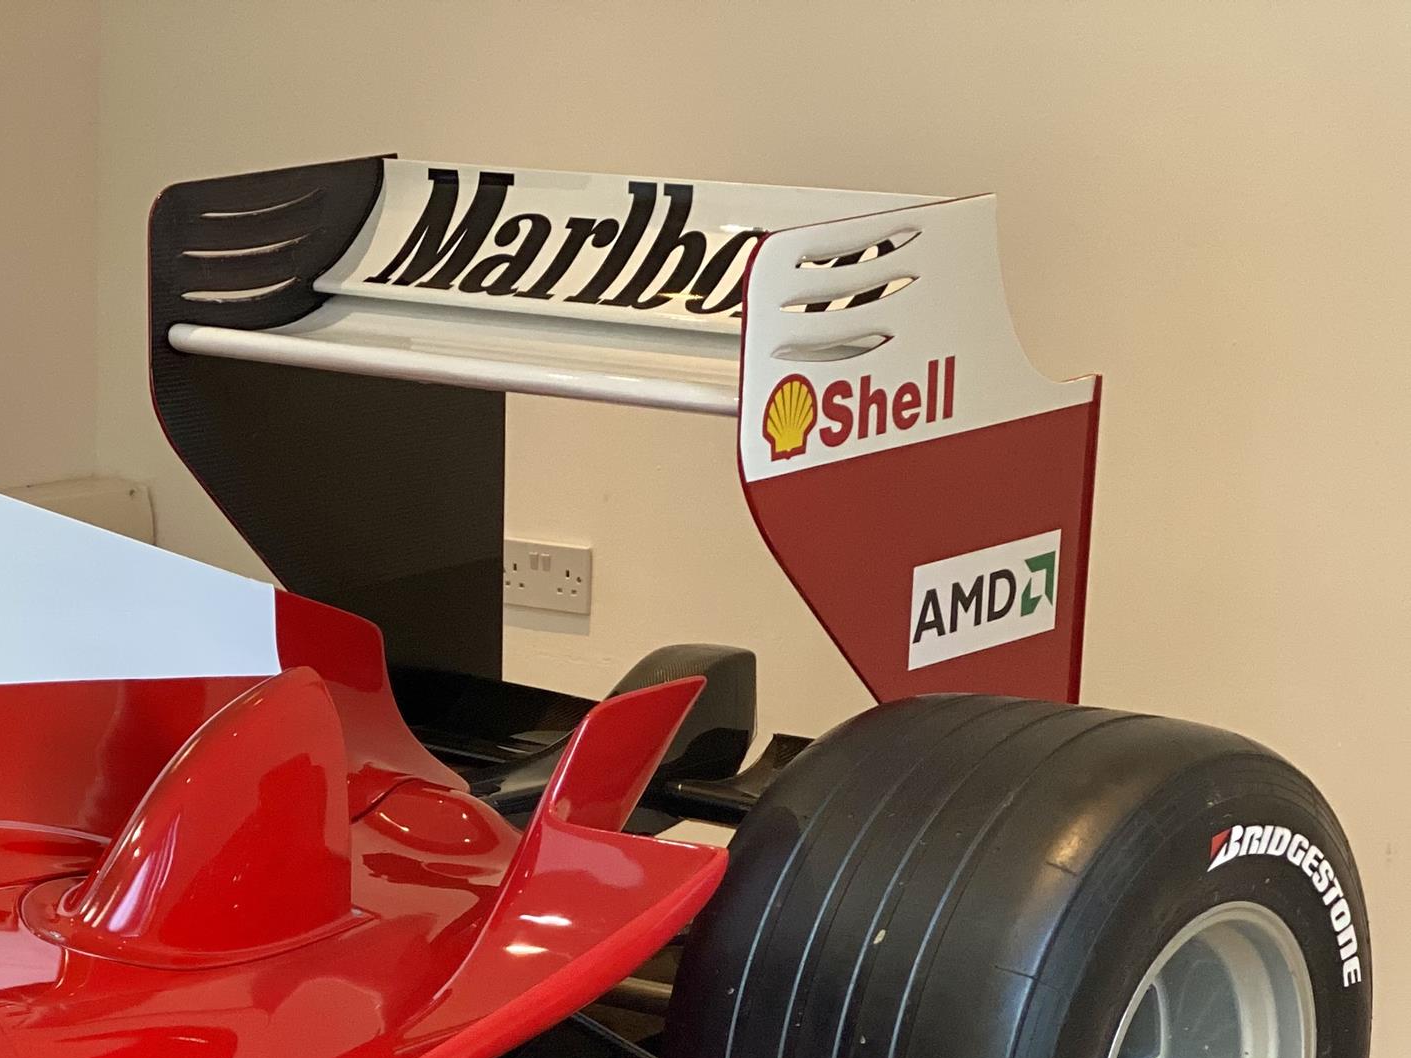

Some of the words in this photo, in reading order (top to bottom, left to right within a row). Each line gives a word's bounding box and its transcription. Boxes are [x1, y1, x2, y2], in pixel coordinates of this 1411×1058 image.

[363, 168, 764, 318] Marlbo
[819, 355, 955, 447] Shell
[912, 568, 1017, 644] AMD
[1206, 824, 1362, 988] BRIDGESTONE
